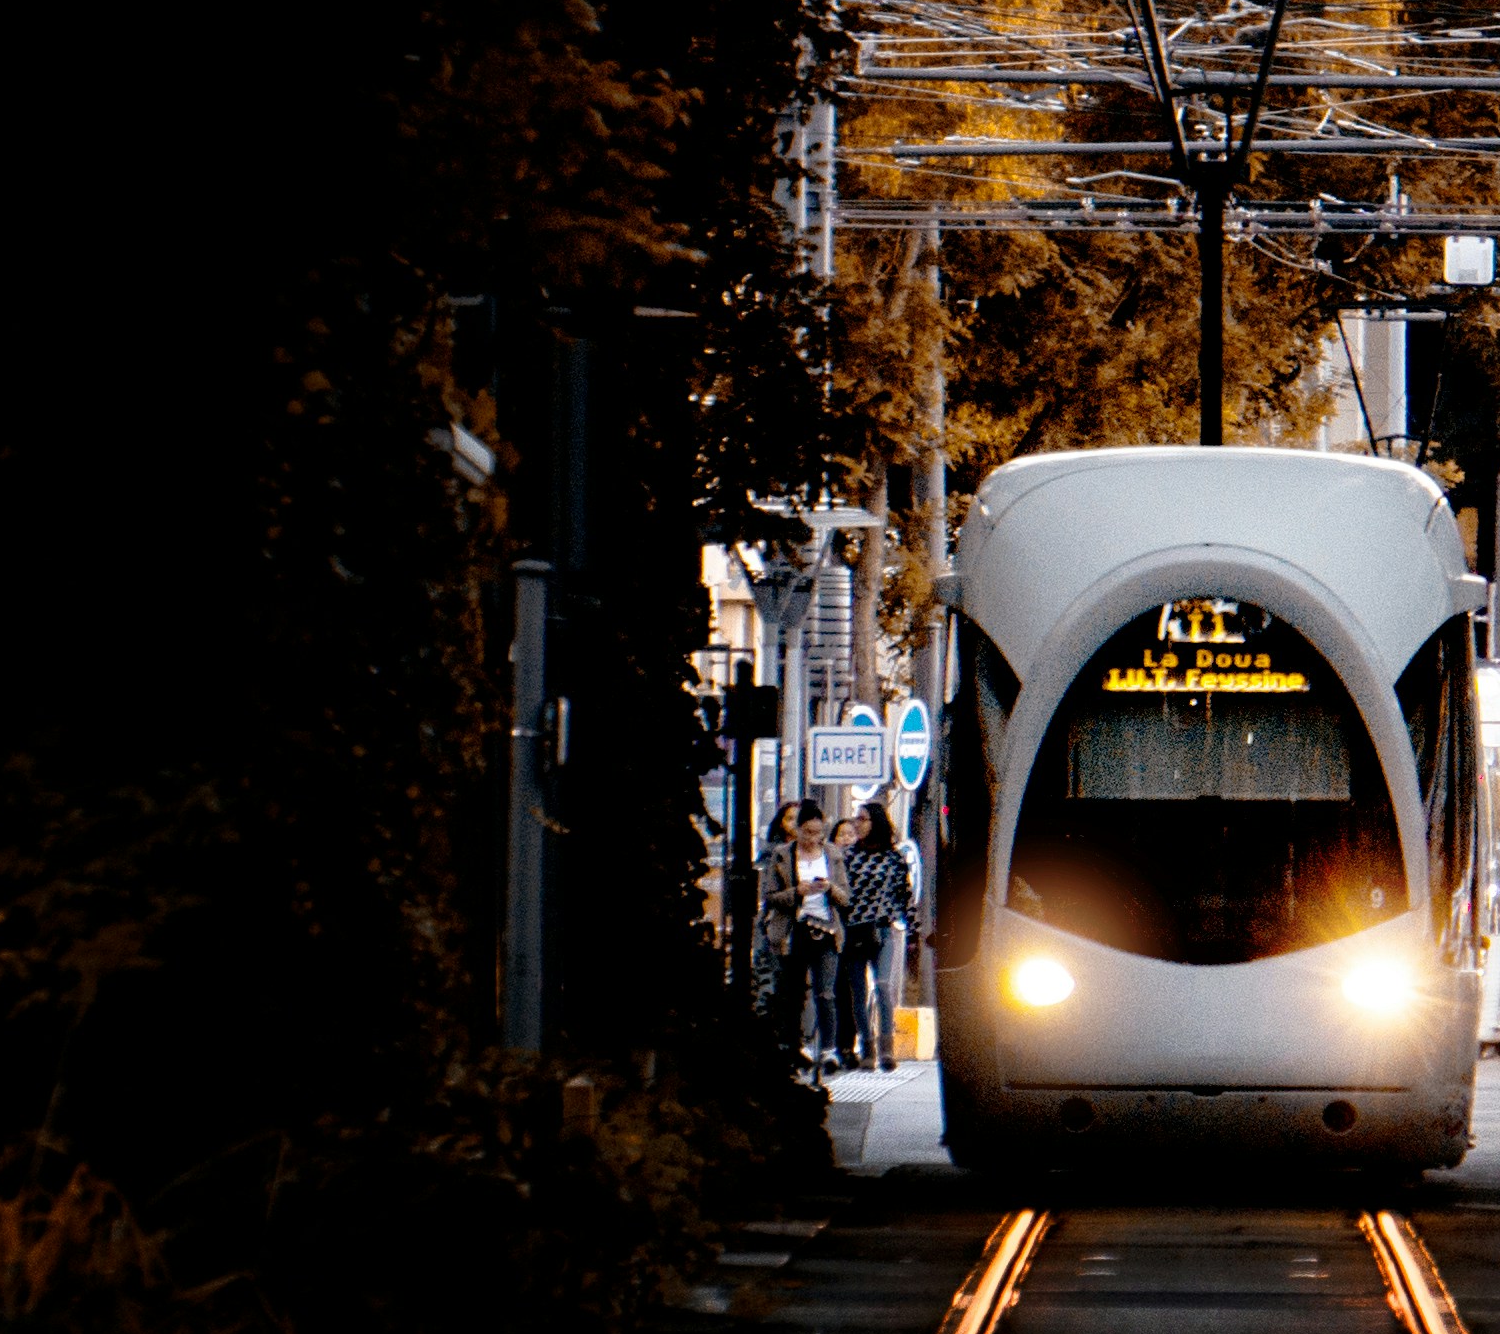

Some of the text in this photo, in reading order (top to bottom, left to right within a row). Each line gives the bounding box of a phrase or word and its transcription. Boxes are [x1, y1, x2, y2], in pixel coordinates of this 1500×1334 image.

[1142, 649, 1272, 668] La Doua
[820, 743, 878, 765] ARRÊT
